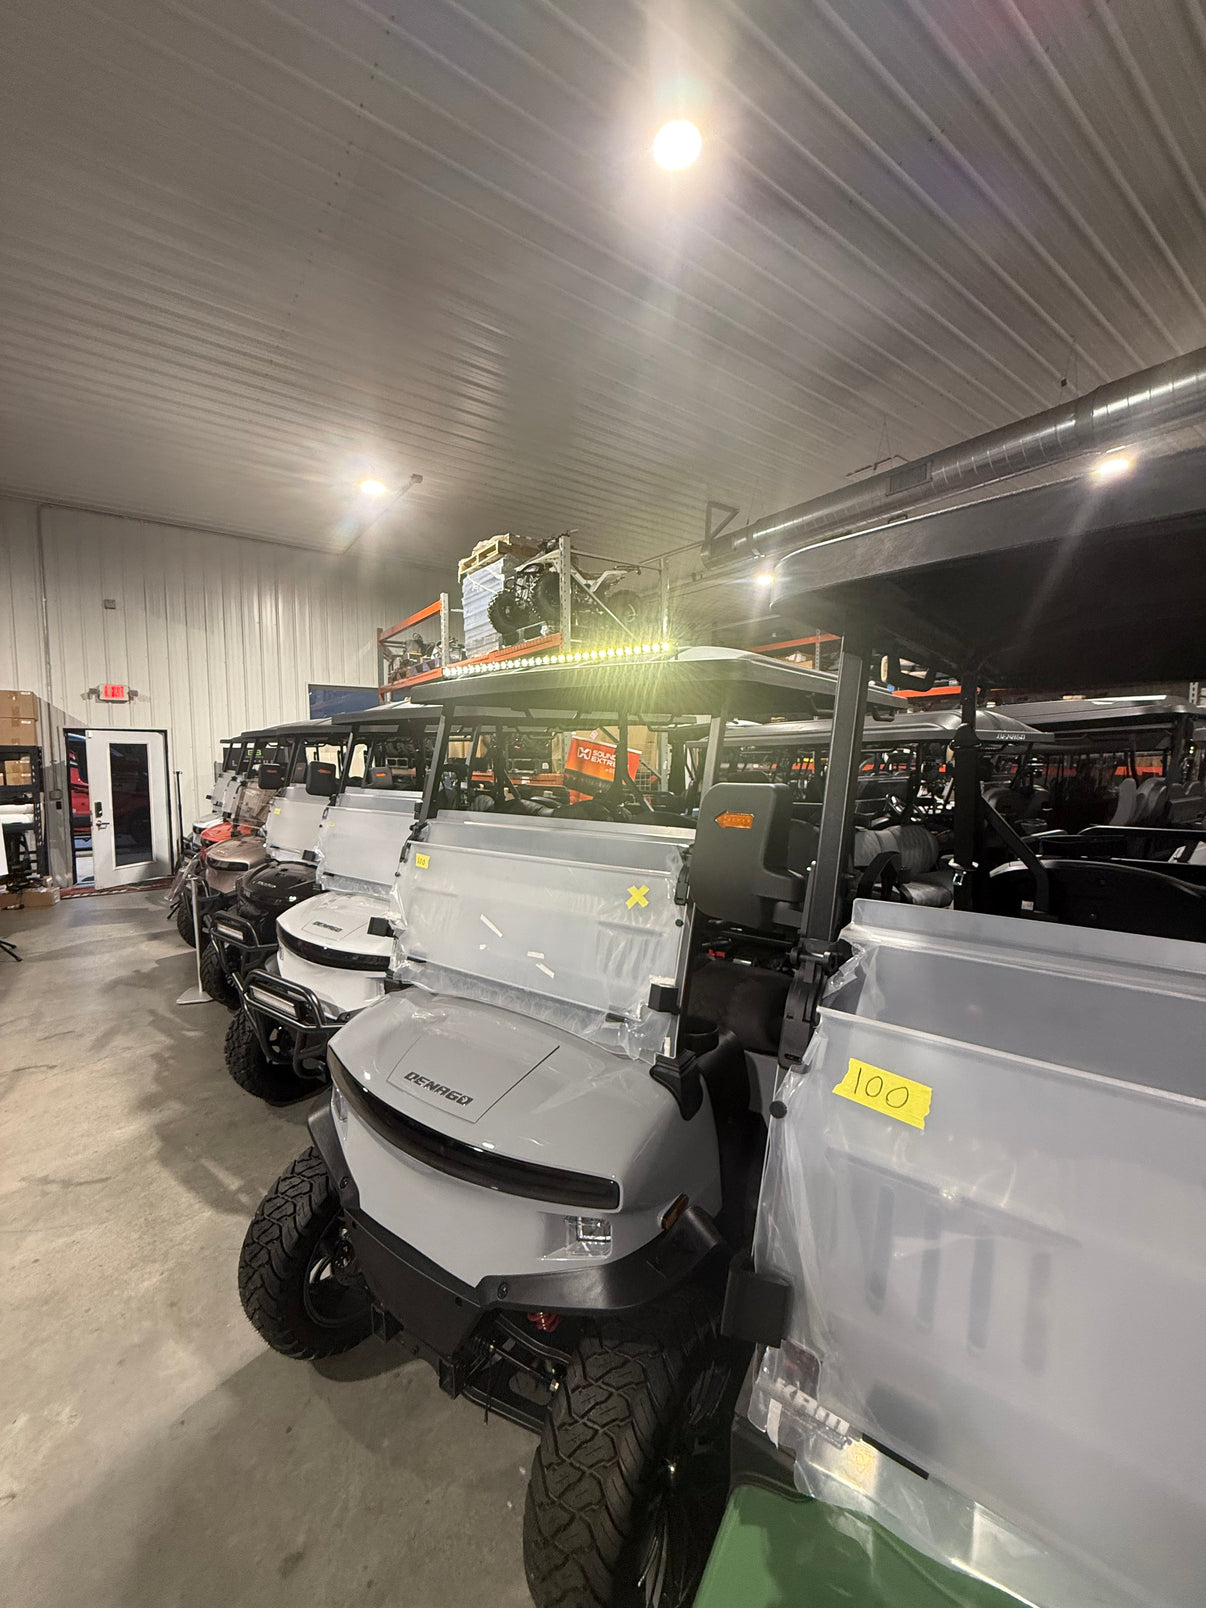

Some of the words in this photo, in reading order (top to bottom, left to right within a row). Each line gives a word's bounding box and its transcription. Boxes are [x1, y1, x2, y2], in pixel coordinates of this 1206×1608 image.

[104, 684, 125, 699] EXIT
[404, 1072, 474, 1106] DENAGO
[854, 1067, 909, 1109] 100
